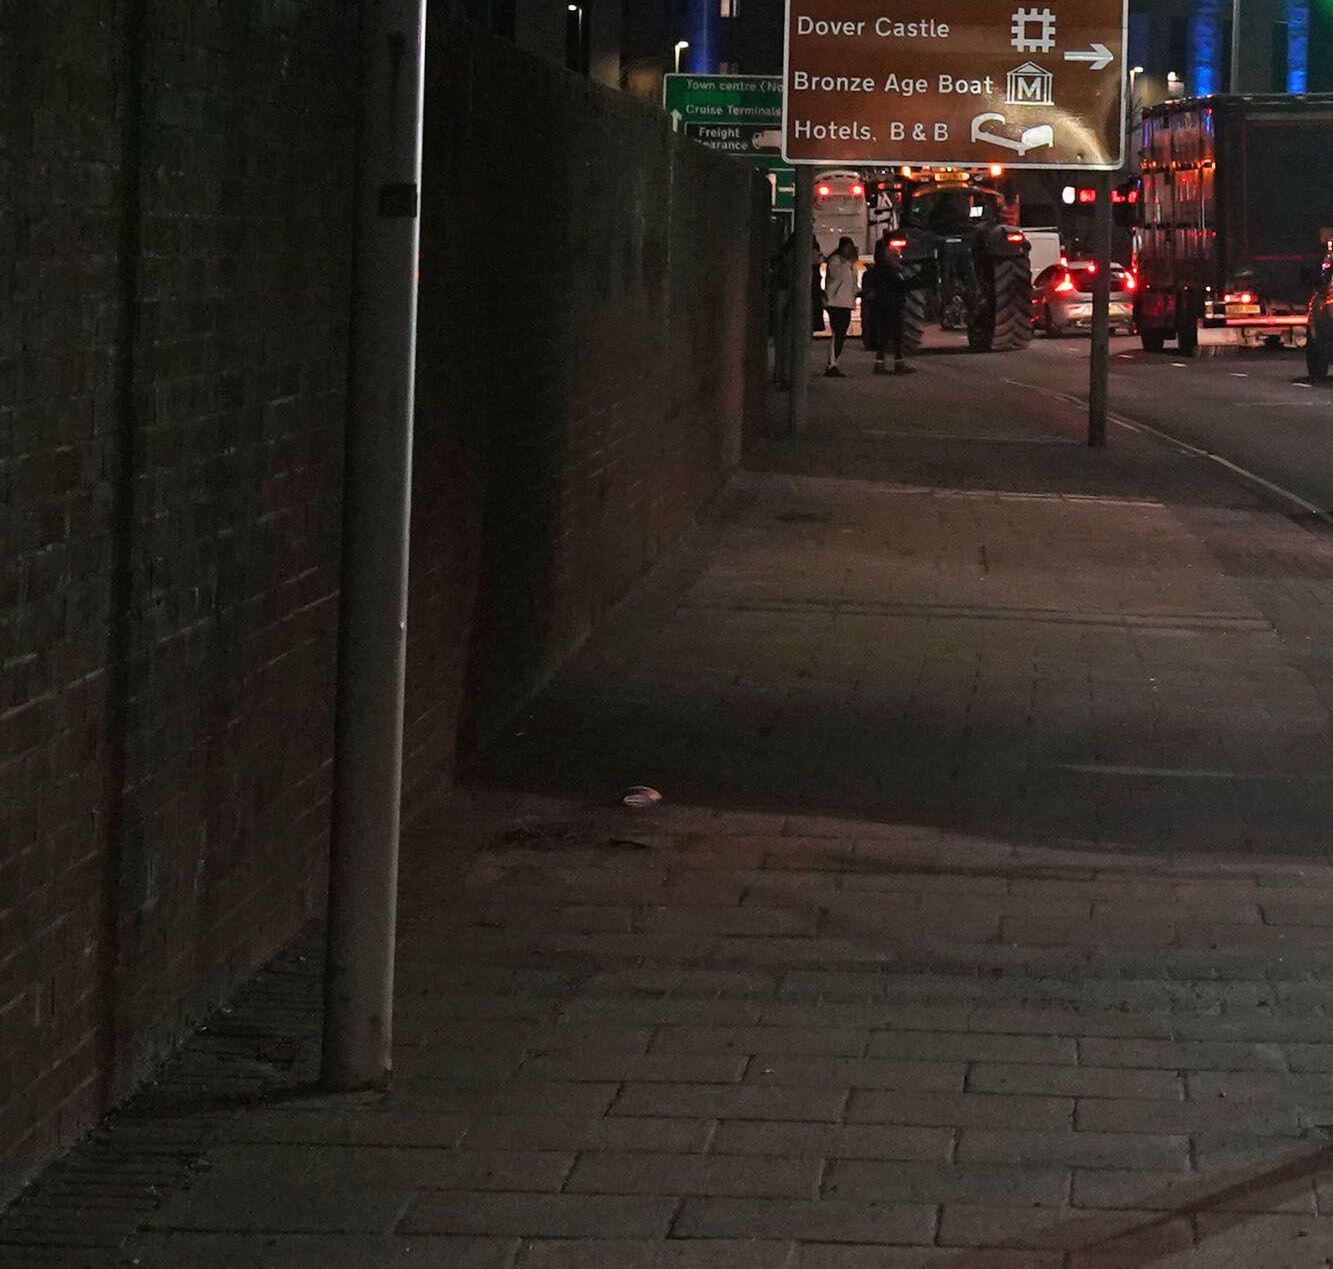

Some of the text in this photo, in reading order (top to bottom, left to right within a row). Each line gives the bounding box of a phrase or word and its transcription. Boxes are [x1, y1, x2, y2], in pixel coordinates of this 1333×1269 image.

[797, 15, 951, 39] Dover Castle
[686, 79, 716, 91] Town
[719, 80, 757, 92] centre
[794, 71, 994, 97] Bronze Age Boat
[685, 103, 783, 117] Cruise Terminals
[698, 126, 740, 140] Freight
